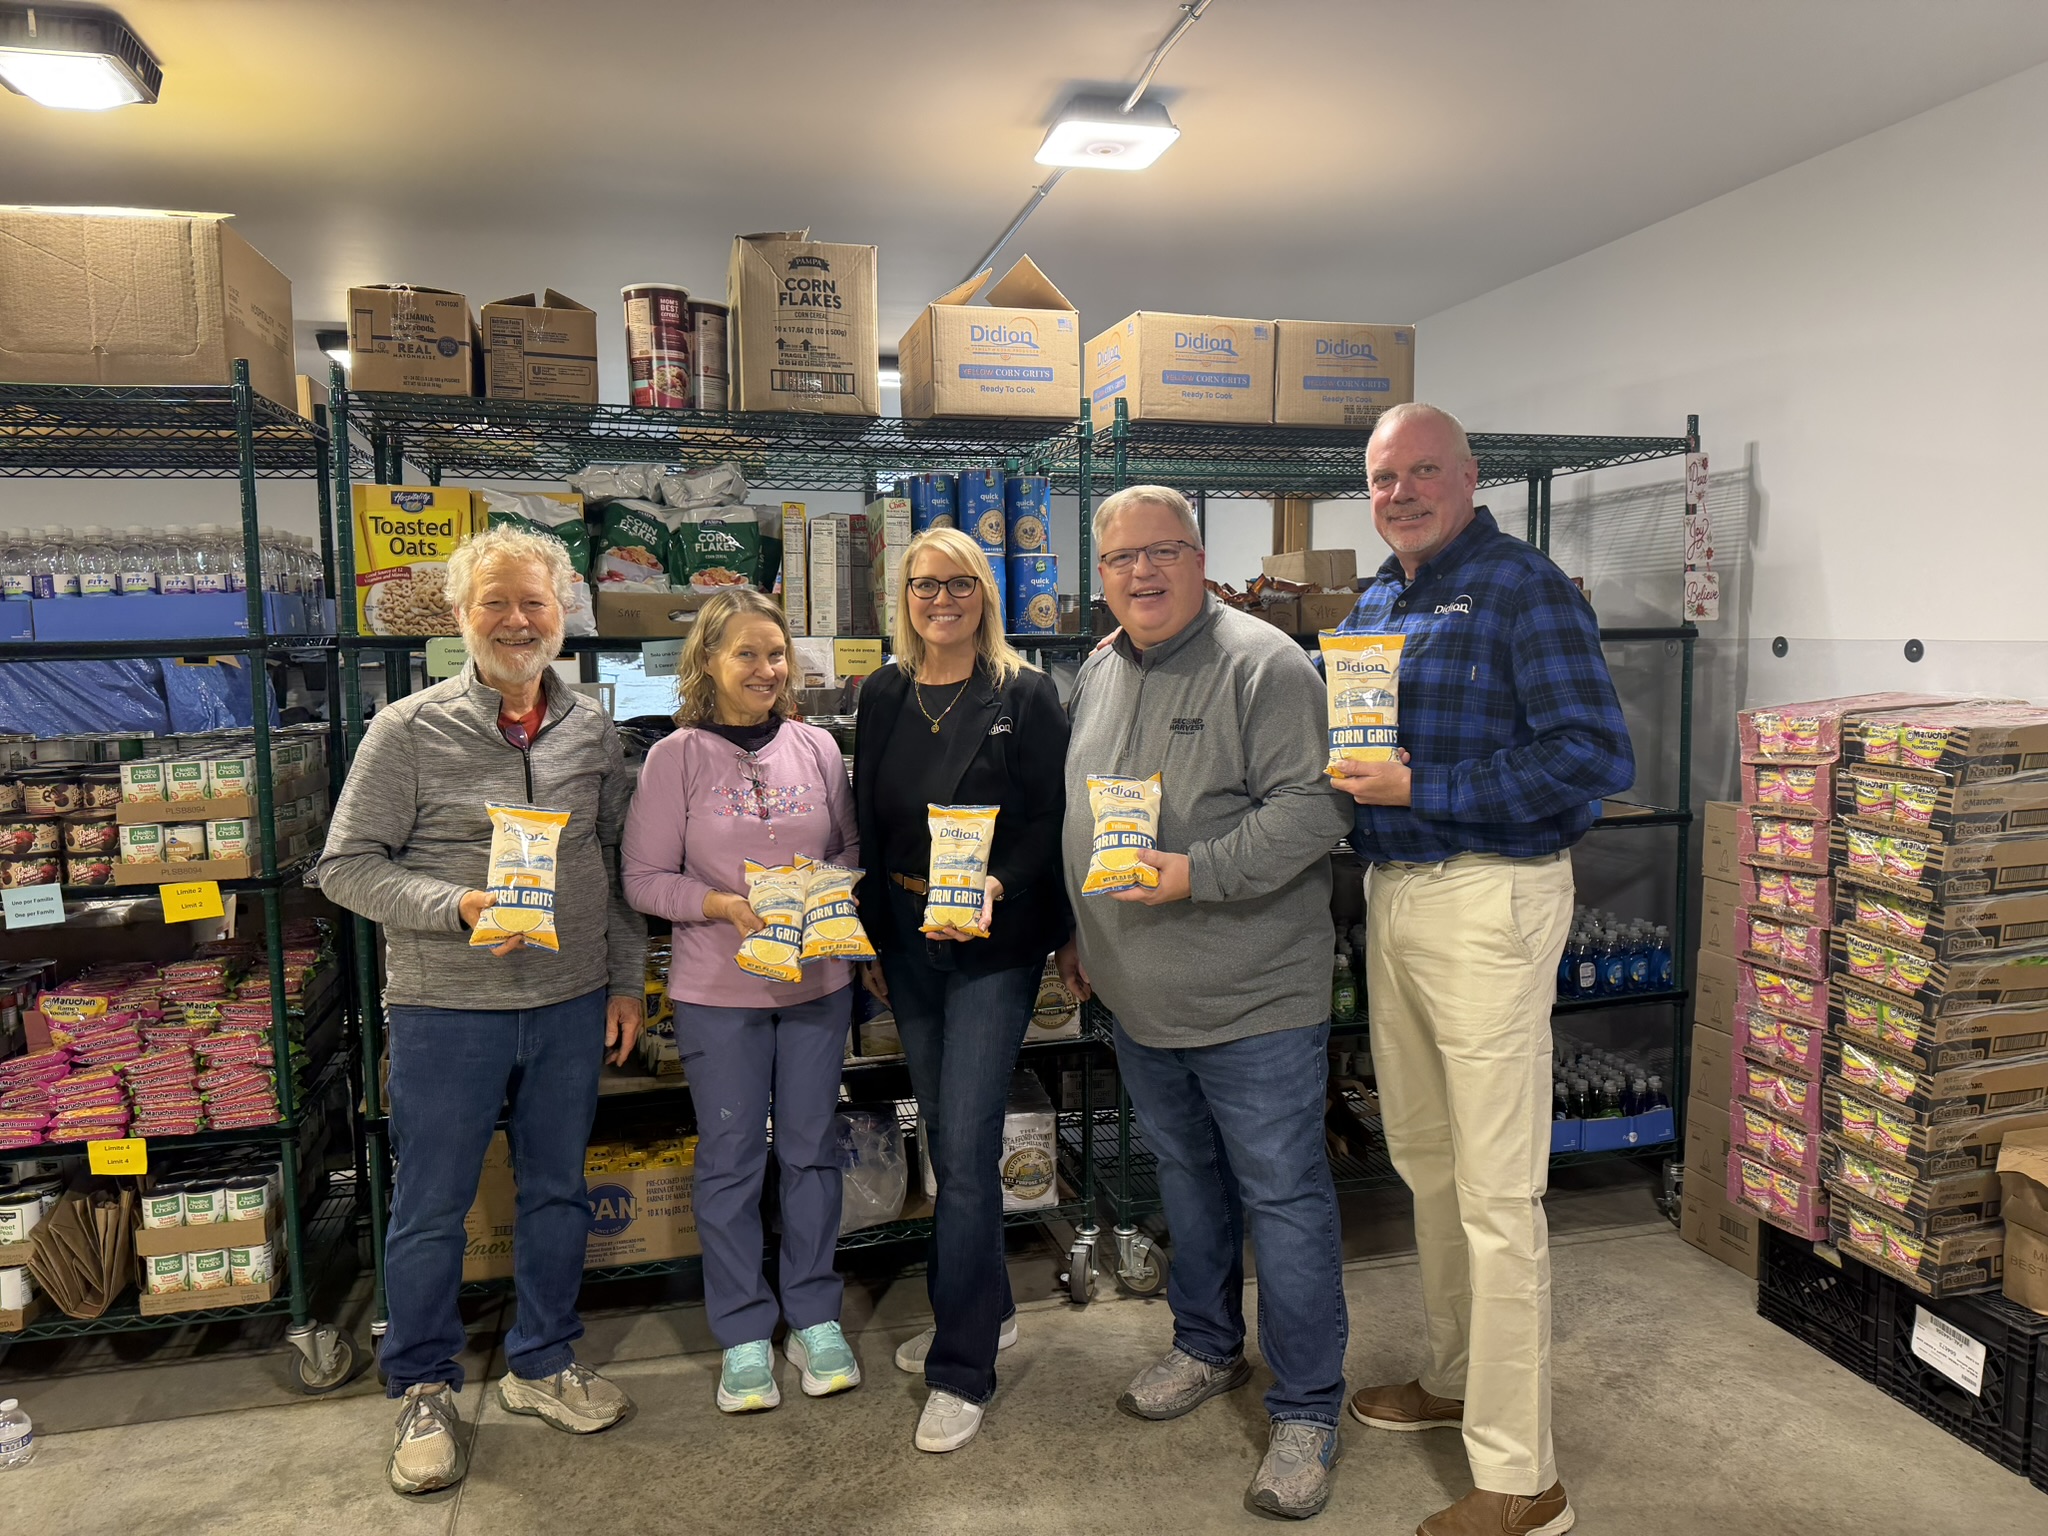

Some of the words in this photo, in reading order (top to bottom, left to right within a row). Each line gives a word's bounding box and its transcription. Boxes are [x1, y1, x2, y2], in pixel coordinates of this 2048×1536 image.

[796, 258, 822, 267] PAMPA
[784, 278, 836, 294] CORN
[779, 292, 842, 310] FLAKES
[810, 312, 828, 320] CEREAL
[971, 325, 1036, 346] Didion
[398, 343, 431, 354] REAL
[1175, 332, 1236, 353] Didion
[1316, 339, 1374, 358] Didion
[962, 368, 993, 376] YELLOW
[995, 368, 1020, 377] CORN
[1022, 369, 1050, 378] GRITS
[1196, 374, 1220, 384] CORN
[1221, 376, 1247, 385] GRITS
[1336, 381, 1360, 389] CORN
[1361, 381, 1387, 389] GRITS
[980, 385, 1004, 394] Ready
[1016, 386, 1036, 394] Cook
[1182, 391, 1203, 400] Ready
[394, 492, 431, 504] Hospitality
[980, 493, 999, 501] quick
[369, 516, 452, 536] Toasted
[625, 514, 658, 535] CORN
[698, 533, 732, 543] CORN
[1687, 517, 1710, 561] Joy
[390, 538, 437, 556] Oats
[695, 541, 736, 552] FLAKES
[1687, 581, 1719, 605] Believe
[618, 609, 641, 618] SAVE
[1434, 602, 1469, 615] Didion
[1337, 661, 1386, 673] Didion
[1355, 715, 1376, 724] Yellow
[1333, 729, 1363, 744] CORN
[1368, 729, 1398, 744] GRITS
[1913, 730, 1948, 740] Marucha
[1895, 771, 1910, 780] Chili
[1911, 774, 1934, 783] Shrimp
[1969, 766, 2012, 778] Ramen
[1781, 806, 1805, 815] Shrimp
[940, 827, 981, 841] Didion
[1875, 821, 1890, 830] Lime
[1906, 828, 1930, 839] Shrimp
[1958, 823, 1999, 835] Ramen
[1093, 833, 1118, 852] CORN
[1122, 833, 1152, 849] GRITS
[1781, 857, 1806, 869] Shrimp
[176, 888, 196, 896] Limite
[1897, 884, 1921, 897] Shrimp
[1948, 880, 1989, 893] Ramen
[522, 890, 553, 906] GRITS
[954, 890, 982, 905] GRITS
[806, 905, 833, 924] CORN
[1849, 937, 1883, 953] Maruchan
[1951, 937, 1992, 948] Ramen
[51, 997, 96, 1006] Maruchan
[1940, 1049, 1982, 1062] Ramen
[135, 1058, 166, 1070] Maruchan
[1775, 1057, 1799, 1073] Shrimp
[2, 1076, 33, 1086] Maruchan
[1933, 1157, 1975, 1169] Ramen
[239, 1198, 261, 1207] Choice
[154, 1206, 177, 1214] Choice
[1766, 1211, 1791, 1229] Shrimp
[1934, 1215, 1975, 1228] Ramen
[157, 1263, 180, 1272] Choice
[198, 1260, 220, 1269] Choice
[2010, 1255, 2046, 1278] BEST
